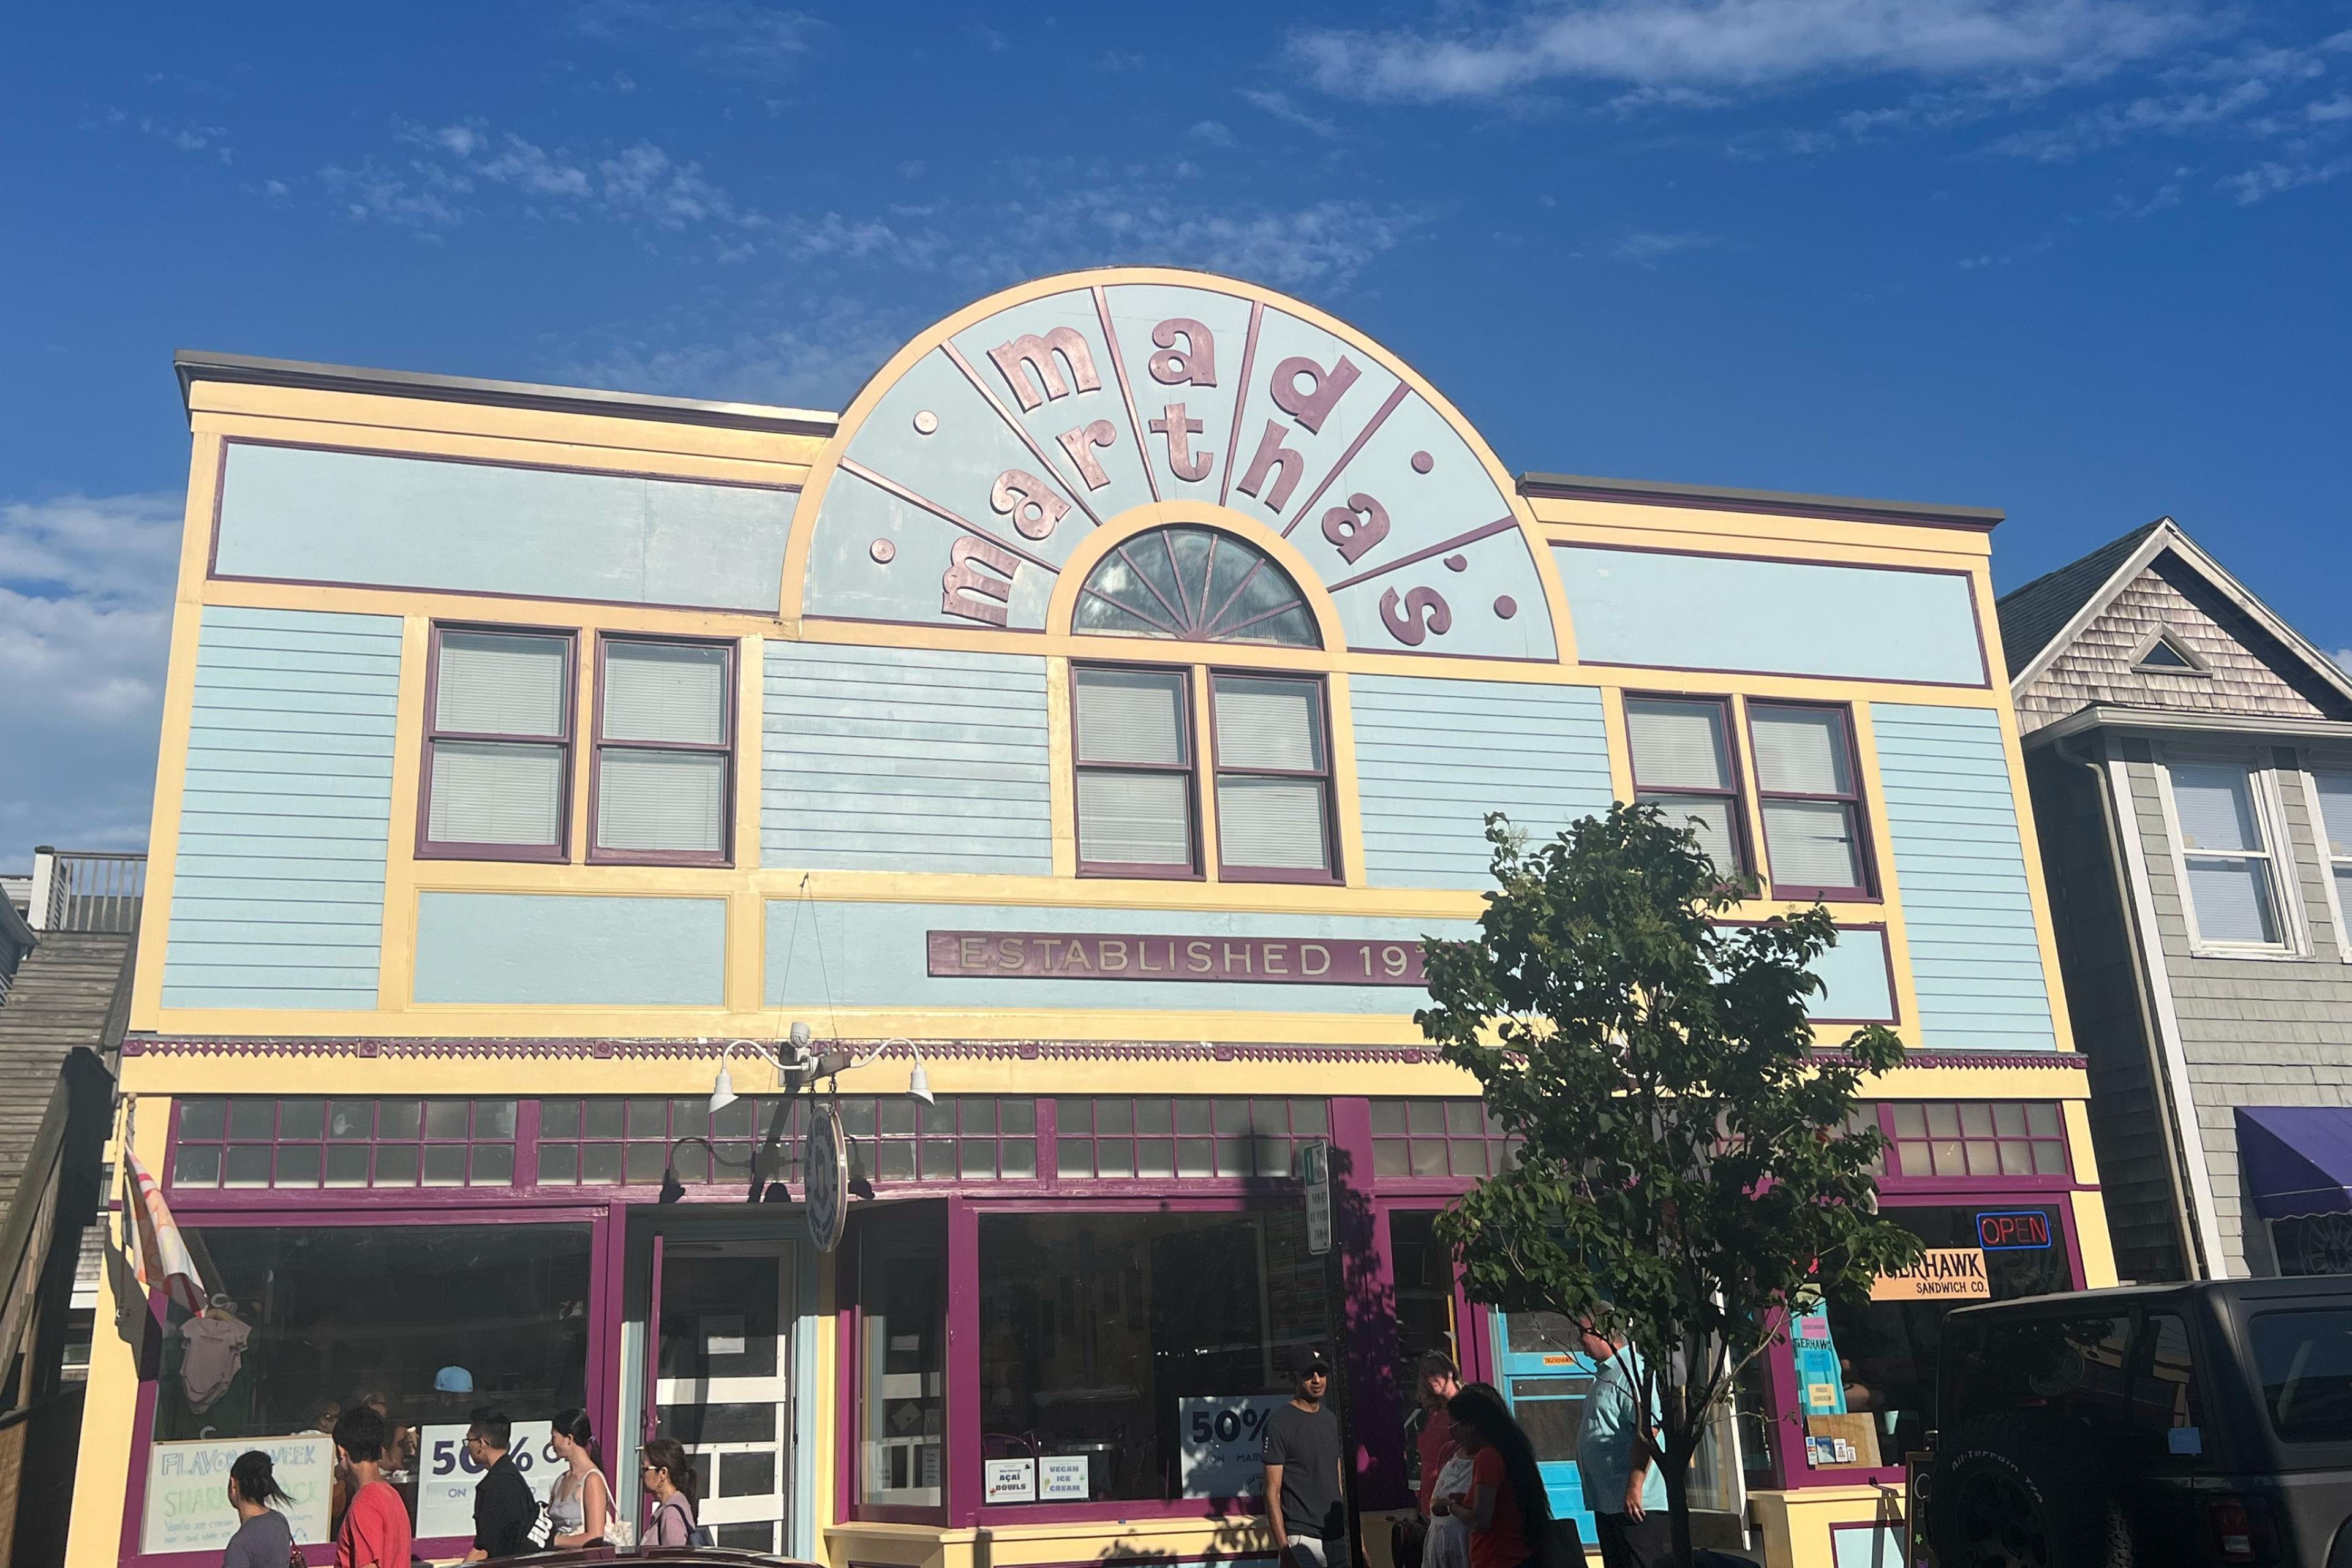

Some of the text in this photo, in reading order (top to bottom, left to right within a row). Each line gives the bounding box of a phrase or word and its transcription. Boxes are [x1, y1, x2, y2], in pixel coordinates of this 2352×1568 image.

[986, 317, 1362, 434] mad
[941, 402, 1468, 647] martha's
[959, 936, 1331, 976] ESTABLISHED
[1980, 1216, 2048, 1245] OPEN
[1917, 1281, 1988, 1295] SANDWICH CO.
[1210, 1453, 1225, 1463] ON
[448, 1488, 467, 1498] ON
